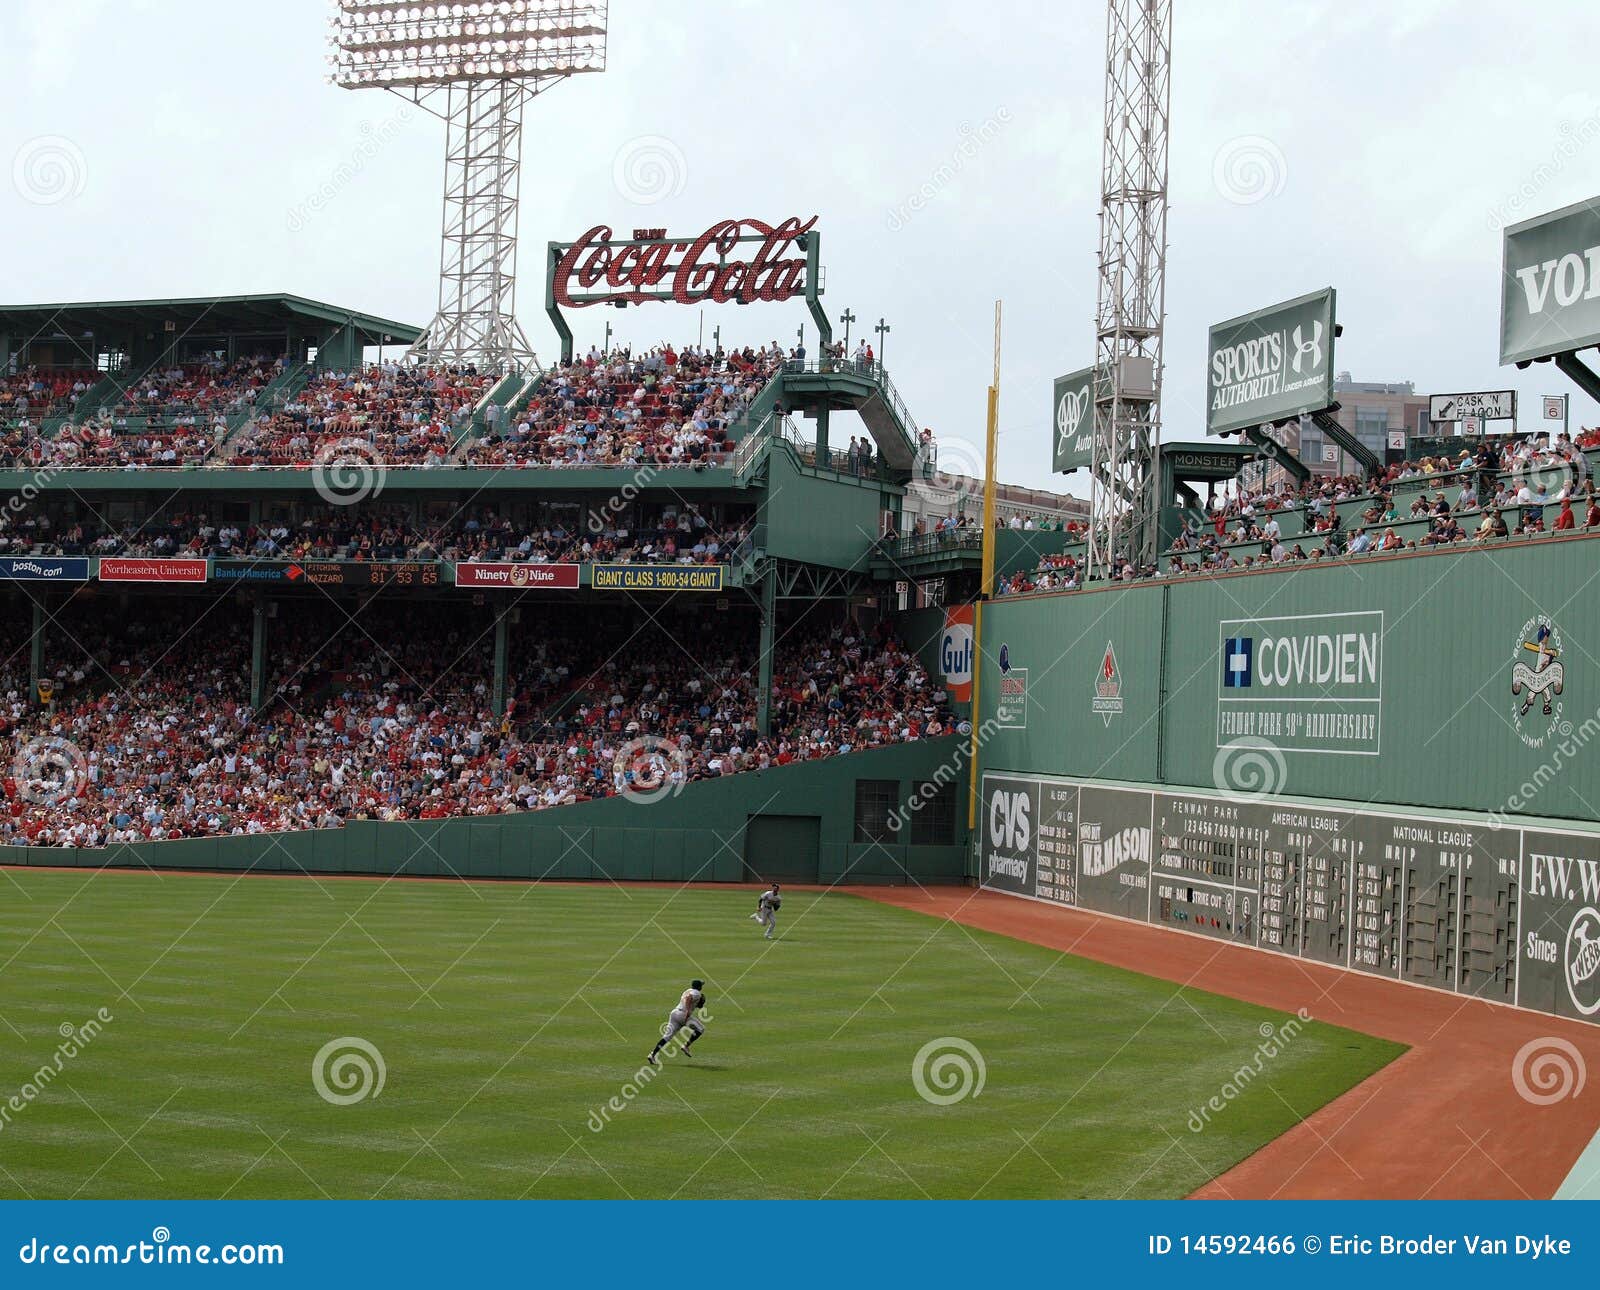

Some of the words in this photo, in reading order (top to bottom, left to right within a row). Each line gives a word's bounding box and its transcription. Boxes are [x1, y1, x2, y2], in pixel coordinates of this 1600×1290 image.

[553, 215, 818, 308] Coca-Cola
[1212, 332, 1281, 387] SPORTS
[1457, 397, 1484, 407] CASK
[1549, 408, 1558, 417] 6
[1467, 424, 1475, 433] 5
[1074, 434, 1092, 452] Auto
[1392, 440, 1402, 448] 4
[1175, 454, 1237, 466] MONSTER
[1327, 452, 1334, 460] 3
[105, 565, 158, 576] Northeastern
[160, 565, 201, 577] University
[307, 574, 343, 583] MAZZARO
[371, 572, 385, 583] 81
[397, 572, 413, 583] 53
[422, 572, 437, 583] 65
[475, 569, 509, 582] Ninety
[513, 569, 525, 581] 99
[529, 570, 554, 580] Nine
[597, 571, 622, 585] GIANT
[625, 571, 653, 586] GLASS
[656, 571, 689, 587] 1-800-54
[690, 572, 716, 587] GIANT
[897, 583, 907, 591] 33
[1258, 633, 1376, 686] COVIDIEN
[1221, 711, 1255, 735] FENWAY
[1258, 712, 1281, 736] PARK
[1306, 713, 1375, 740] ANNIVERSARY
[1173, 801, 1207, 817] FENWAY
[1214, 806, 1238, 820] PARK
[990, 789, 1030, 852] CVS
[1271, 813, 1308, 827] AMERICAN
[1310, 817, 1339, 831] LEAGUE
[1393, 826, 1434, 843] NATIONAL
[1437, 831, 1472, 847] LEAGUE
[989, 850, 1028, 884] pharmacy
[1366, 881, 1378, 896] FLA
[1192, 890, 1209, 906] STRIKE
[1210, 895, 1222, 909] OUT
[1366, 899, 1377, 914] ATL
[1364, 916, 1377, 931] LAD
[1527, 931, 1557, 963] Since
[1363, 949, 1376, 965] HOU
